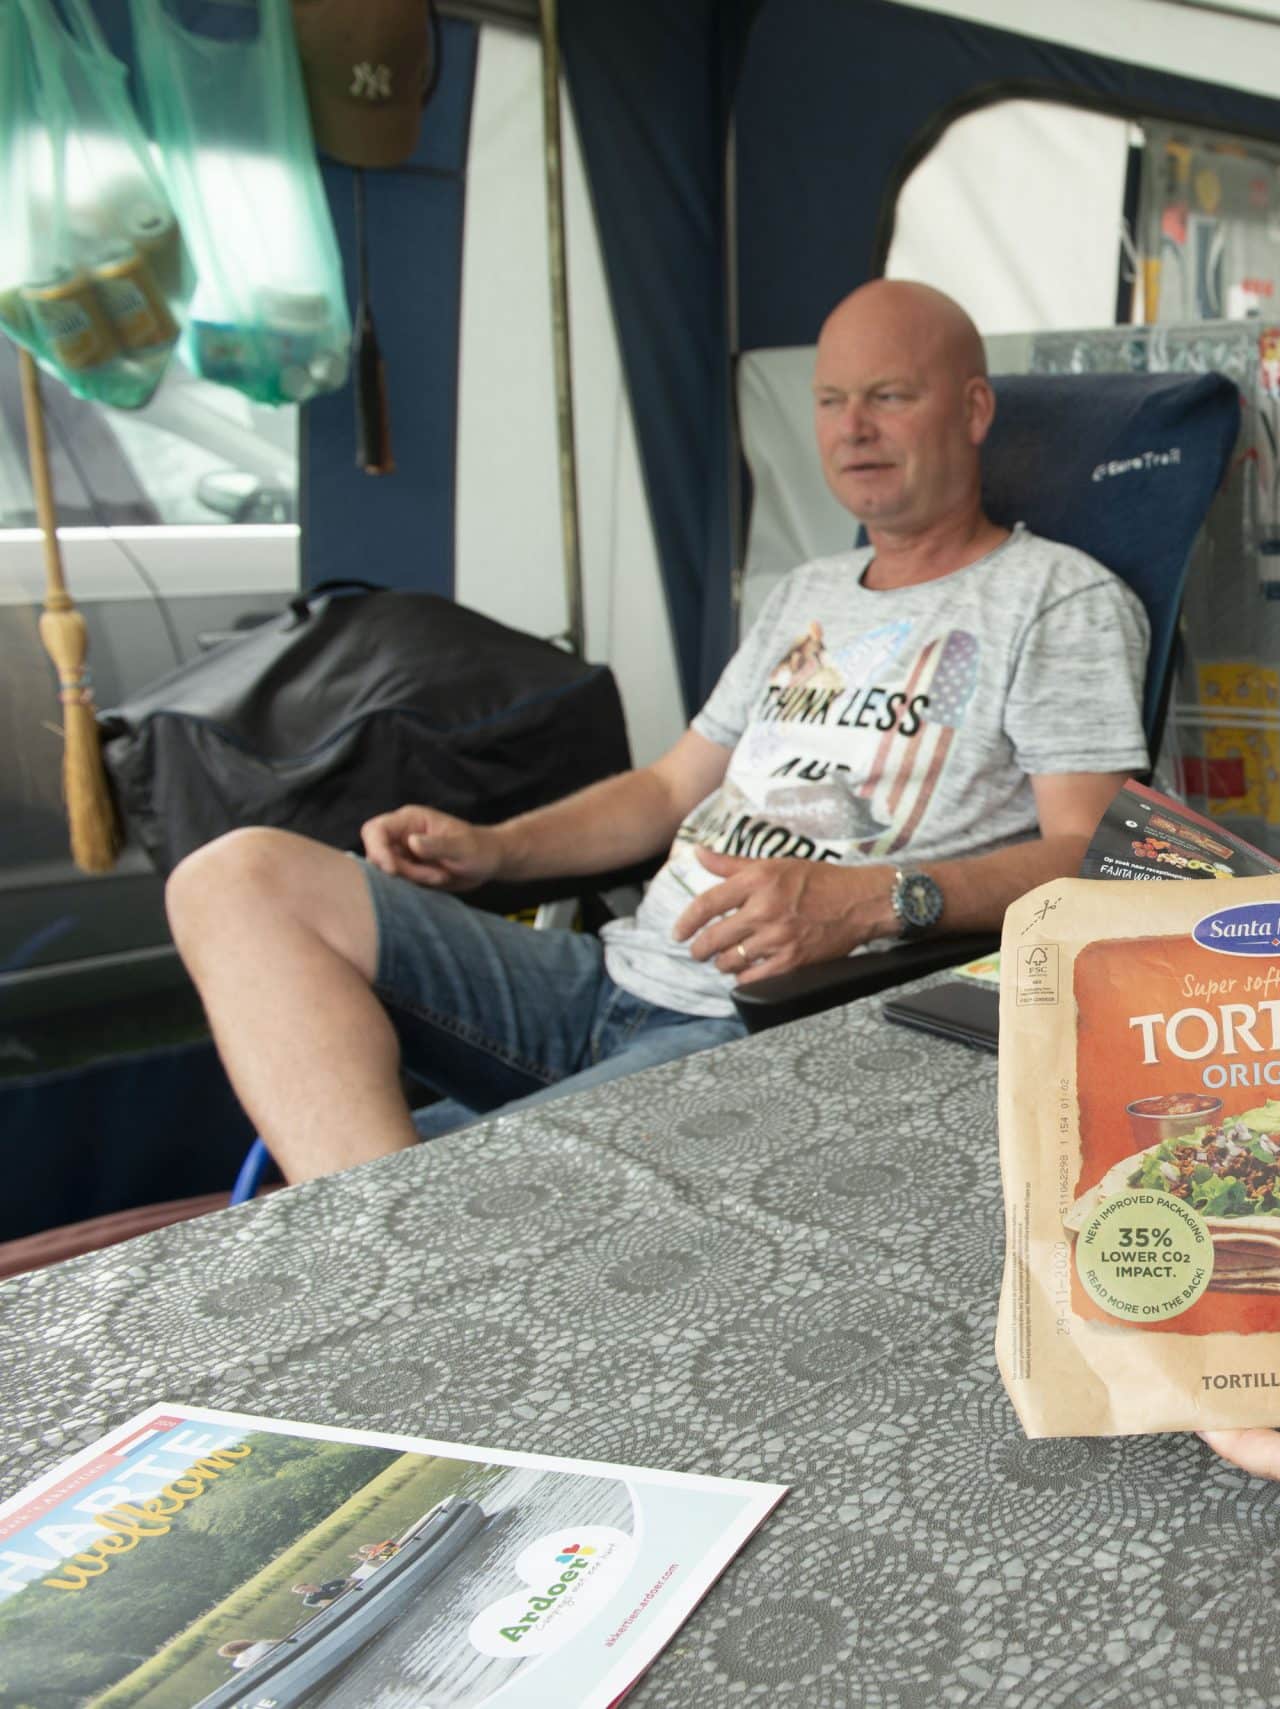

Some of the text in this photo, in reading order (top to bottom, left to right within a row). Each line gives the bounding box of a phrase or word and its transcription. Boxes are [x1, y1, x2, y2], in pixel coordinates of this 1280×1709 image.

[763, 685, 930, 736] THINK LESS
[1100, 864, 1132, 878] FAJITA
[1209, 918, 1272, 939] Santa
[1182, 974, 1237, 1002] Super
[1085, 1195, 1205, 1244] NEW IMPROVED PACKAGING
[1118, 1228, 1173, 1248] 35%
[1101, 1251, 1157, 1263] LOWER
[1116, 1266, 1177, 1278] IMPACT.
[1087, 1268, 1205, 1315] READ MORE ON THE BACK!
[0, 1429, 241, 1592] HARTE
[43, 1442, 252, 1591] welkom
[499, 1557, 589, 1643] Ardoer
